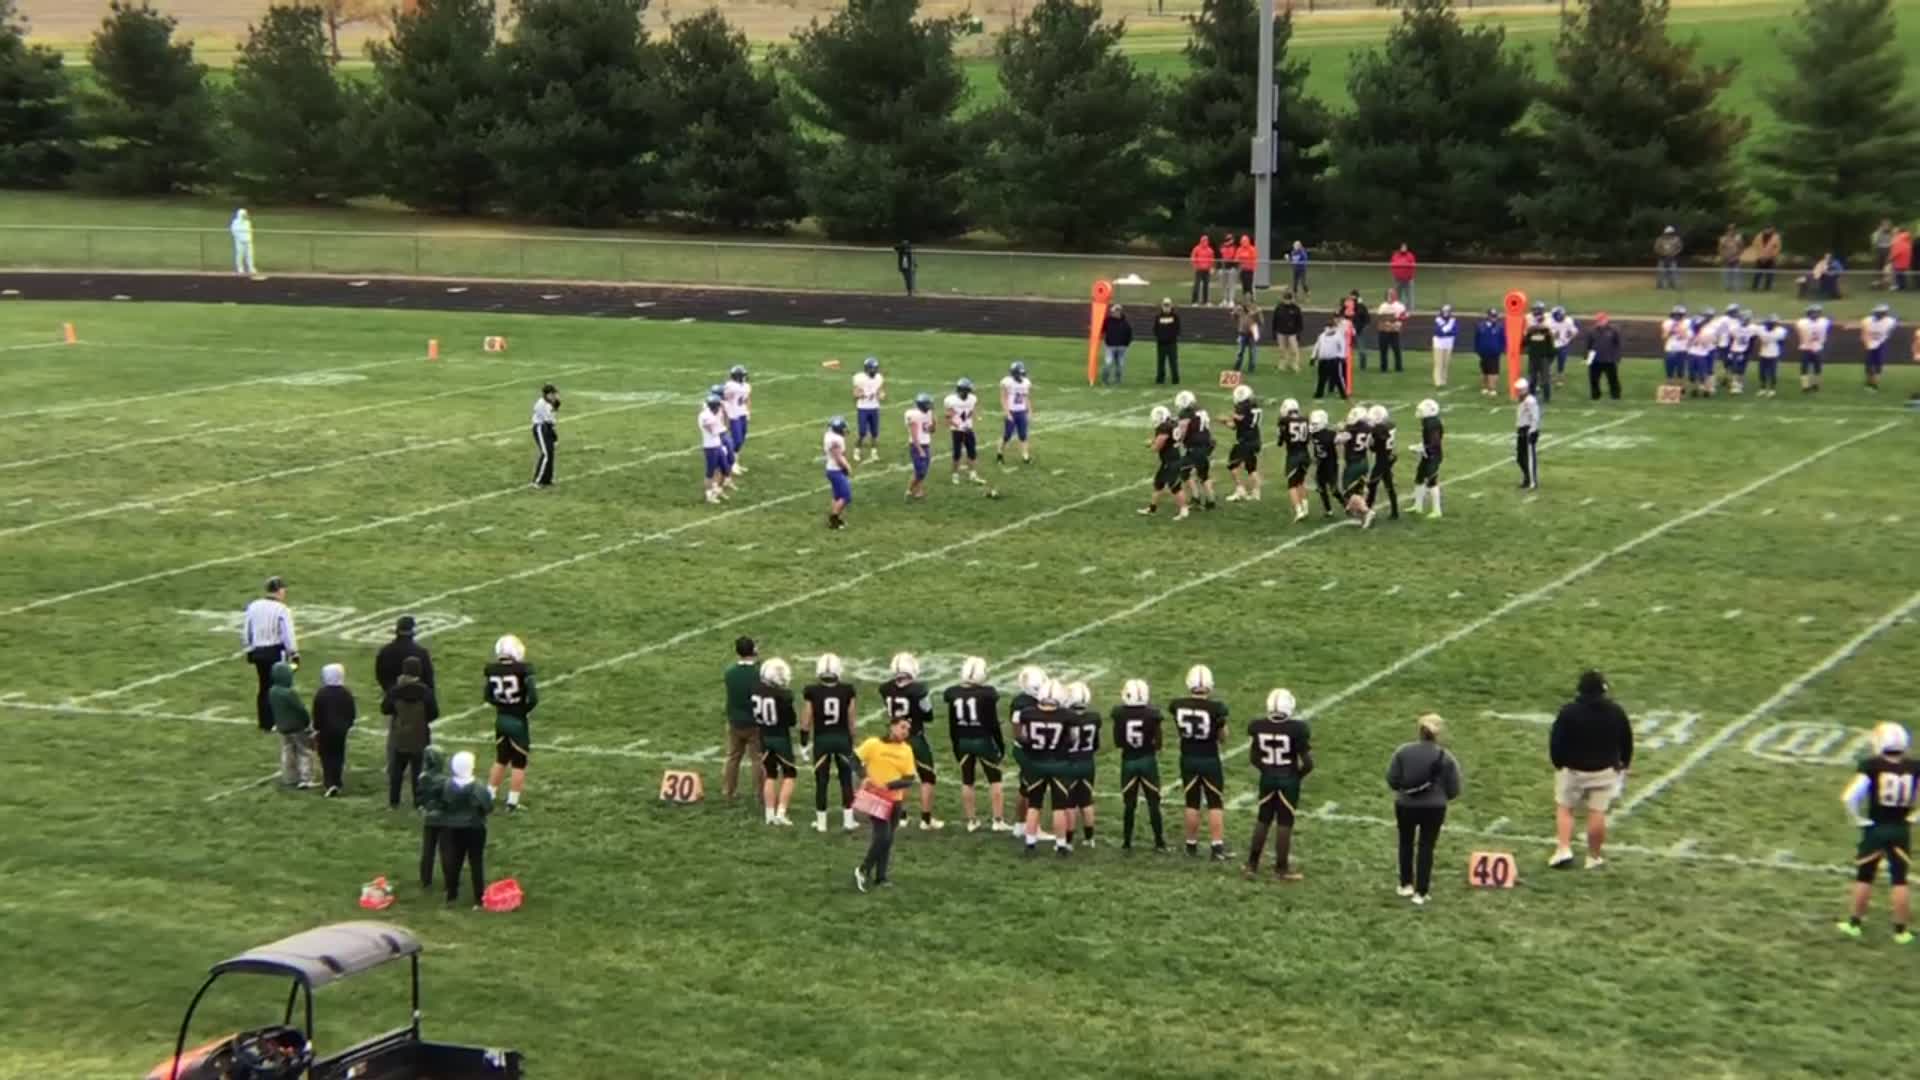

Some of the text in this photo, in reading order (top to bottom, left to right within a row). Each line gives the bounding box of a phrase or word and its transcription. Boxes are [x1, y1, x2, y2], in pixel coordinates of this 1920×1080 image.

[489, 675, 520, 704] 22
[823, 697, 840, 726] 9
[953, 697, 981, 727] 11
[1175, 708, 1210, 740] 53
[1029, 721, 1063, 750] 57
[1125, 719, 1144, 749] 6
[1257, 732, 1291, 766] 52
[663, 774, 695, 800] 30
[1473, 855, 1508, 887] 40
